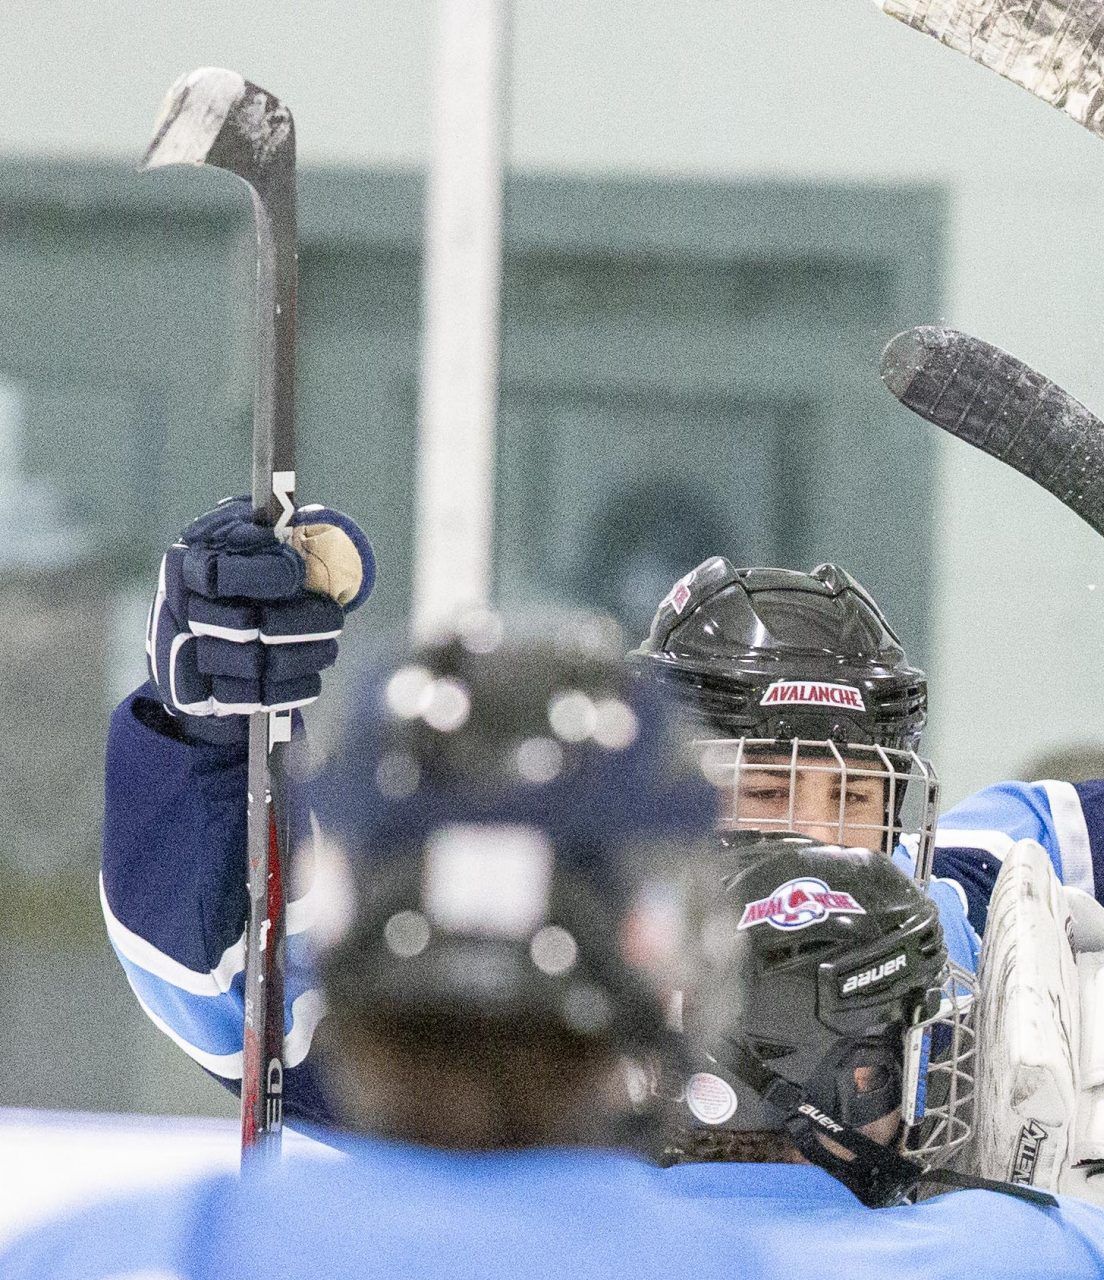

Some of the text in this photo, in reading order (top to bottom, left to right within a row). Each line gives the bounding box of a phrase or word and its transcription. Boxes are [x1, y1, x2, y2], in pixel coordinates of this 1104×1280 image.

[765, 684, 862, 708] AVALANCHE
[842, 954, 907, 994] BAUER
[799, 1102, 844, 1133] AUER
